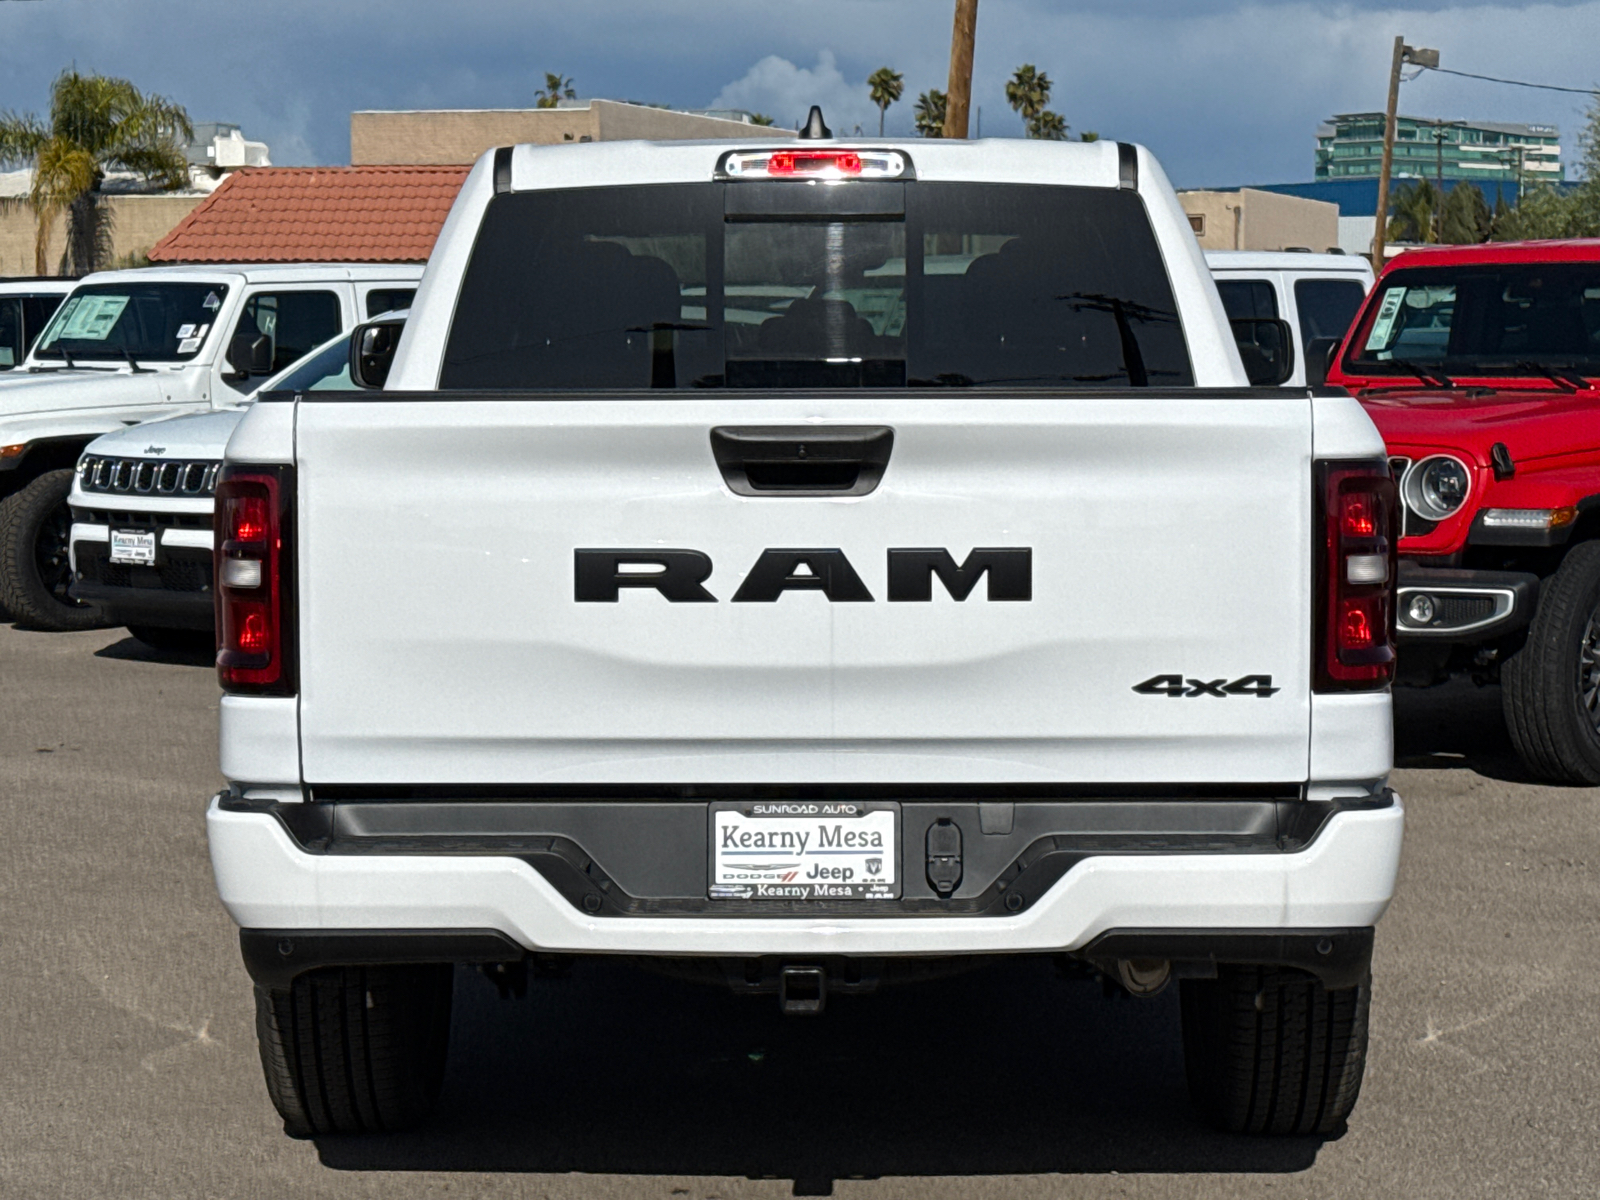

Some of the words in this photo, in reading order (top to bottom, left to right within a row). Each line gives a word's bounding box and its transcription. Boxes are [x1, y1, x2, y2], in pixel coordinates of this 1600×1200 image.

[574, 547, 1033, 602] RAM
[1131, 674, 1281, 698] 4x4
[753, 805, 818, 814] SUNROAD
[822, 805, 857, 814] AUTO
[721, 825, 810, 856] Kearny
[818, 825, 884, 848] Mesa
[806, 863, 854, 882] Jeep
[757, 884, 810, 899] Kearny
[813, 885, 852, 896] Mesa
